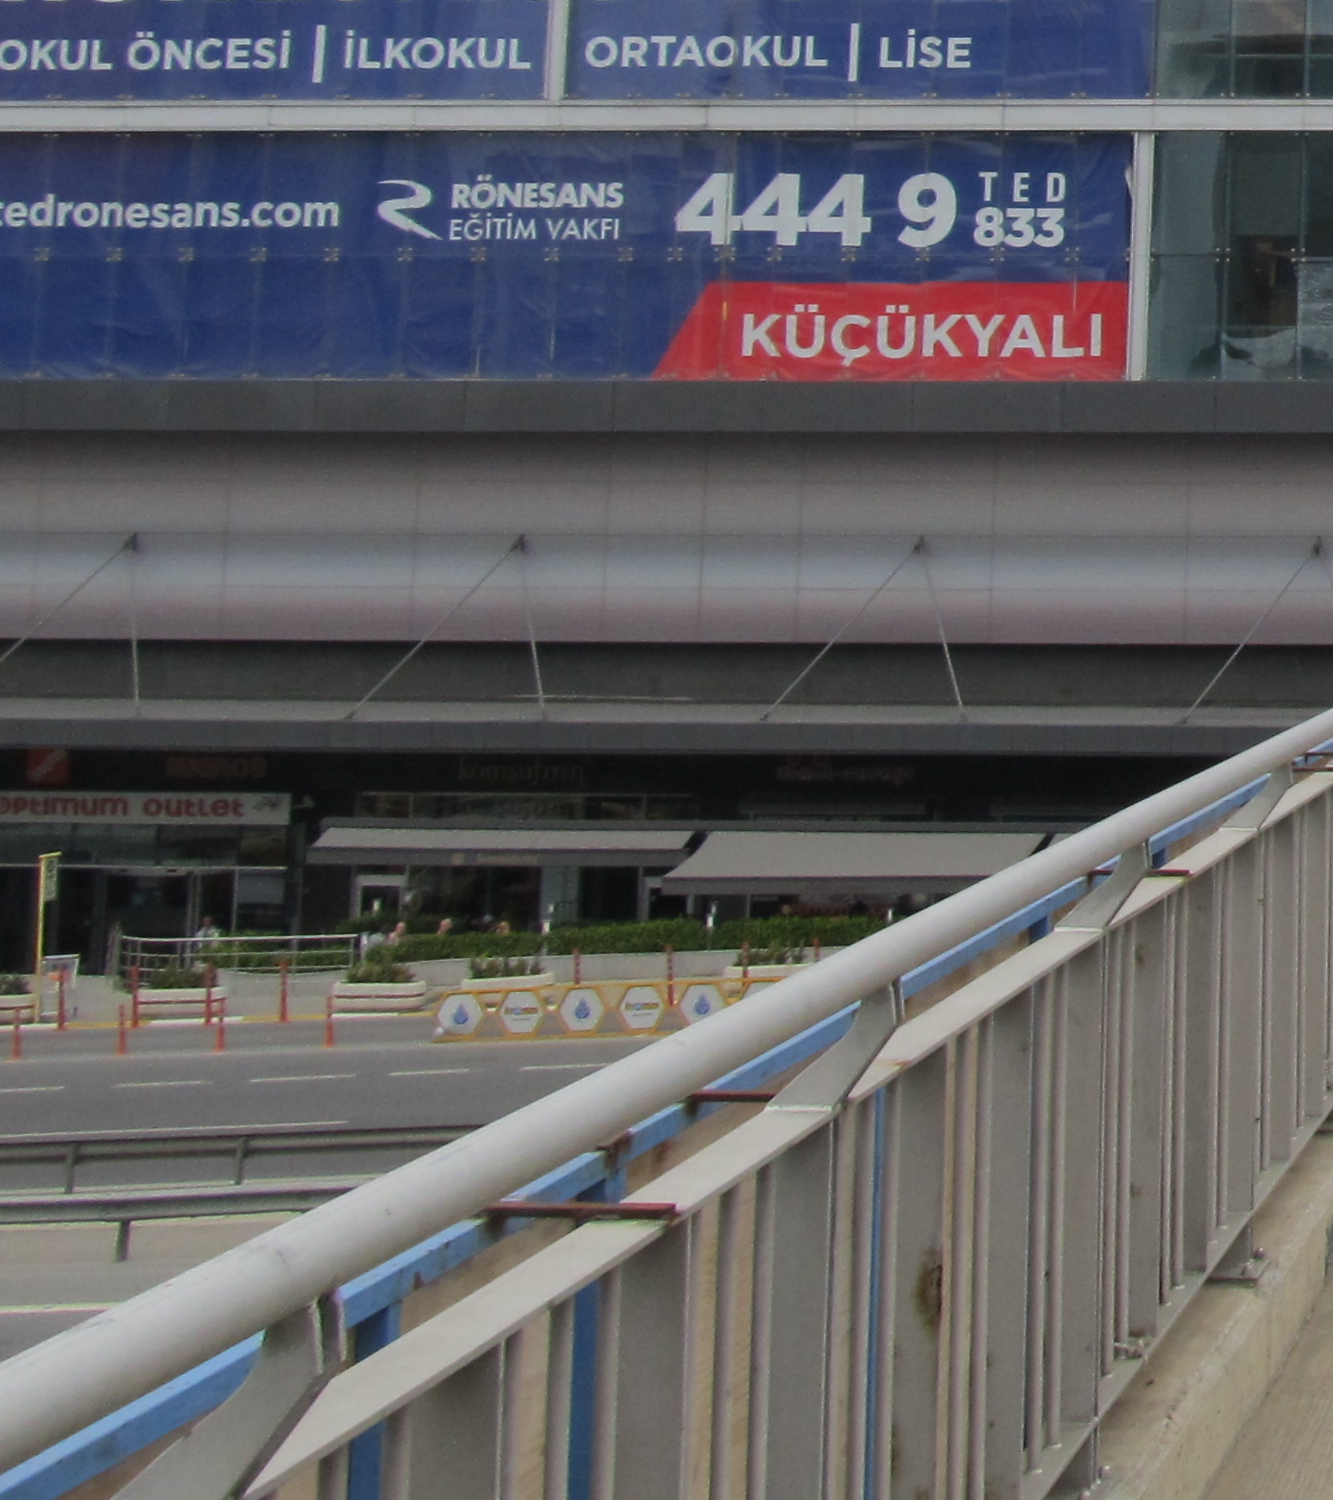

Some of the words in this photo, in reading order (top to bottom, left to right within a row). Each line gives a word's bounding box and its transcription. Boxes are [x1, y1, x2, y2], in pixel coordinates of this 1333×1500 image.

[0, 38, 113, 71] OKUL
[127, 30, 291, 71] ÖNCESİ
[344, 30, 532, 70] İLKOKUL
[585, 35, 829, 69] ORTAOKUL
[879, 29, 972, 69] LİSE
[451, 175, 624, 210] RÖNESANS
[979, 172, 1067, 201] TED
[448, 213, 537, 241] EĞİTİM
[547, 218, 621, 241] VAKFI
[674, 173, 871, 248] 444
[898, 172, 958, 248] 9
[974, 209, 1066, 248] 833
[741, 304, 1102, 367] KÜÇÜKYALI
[142, 797, 246, 818] outlet
